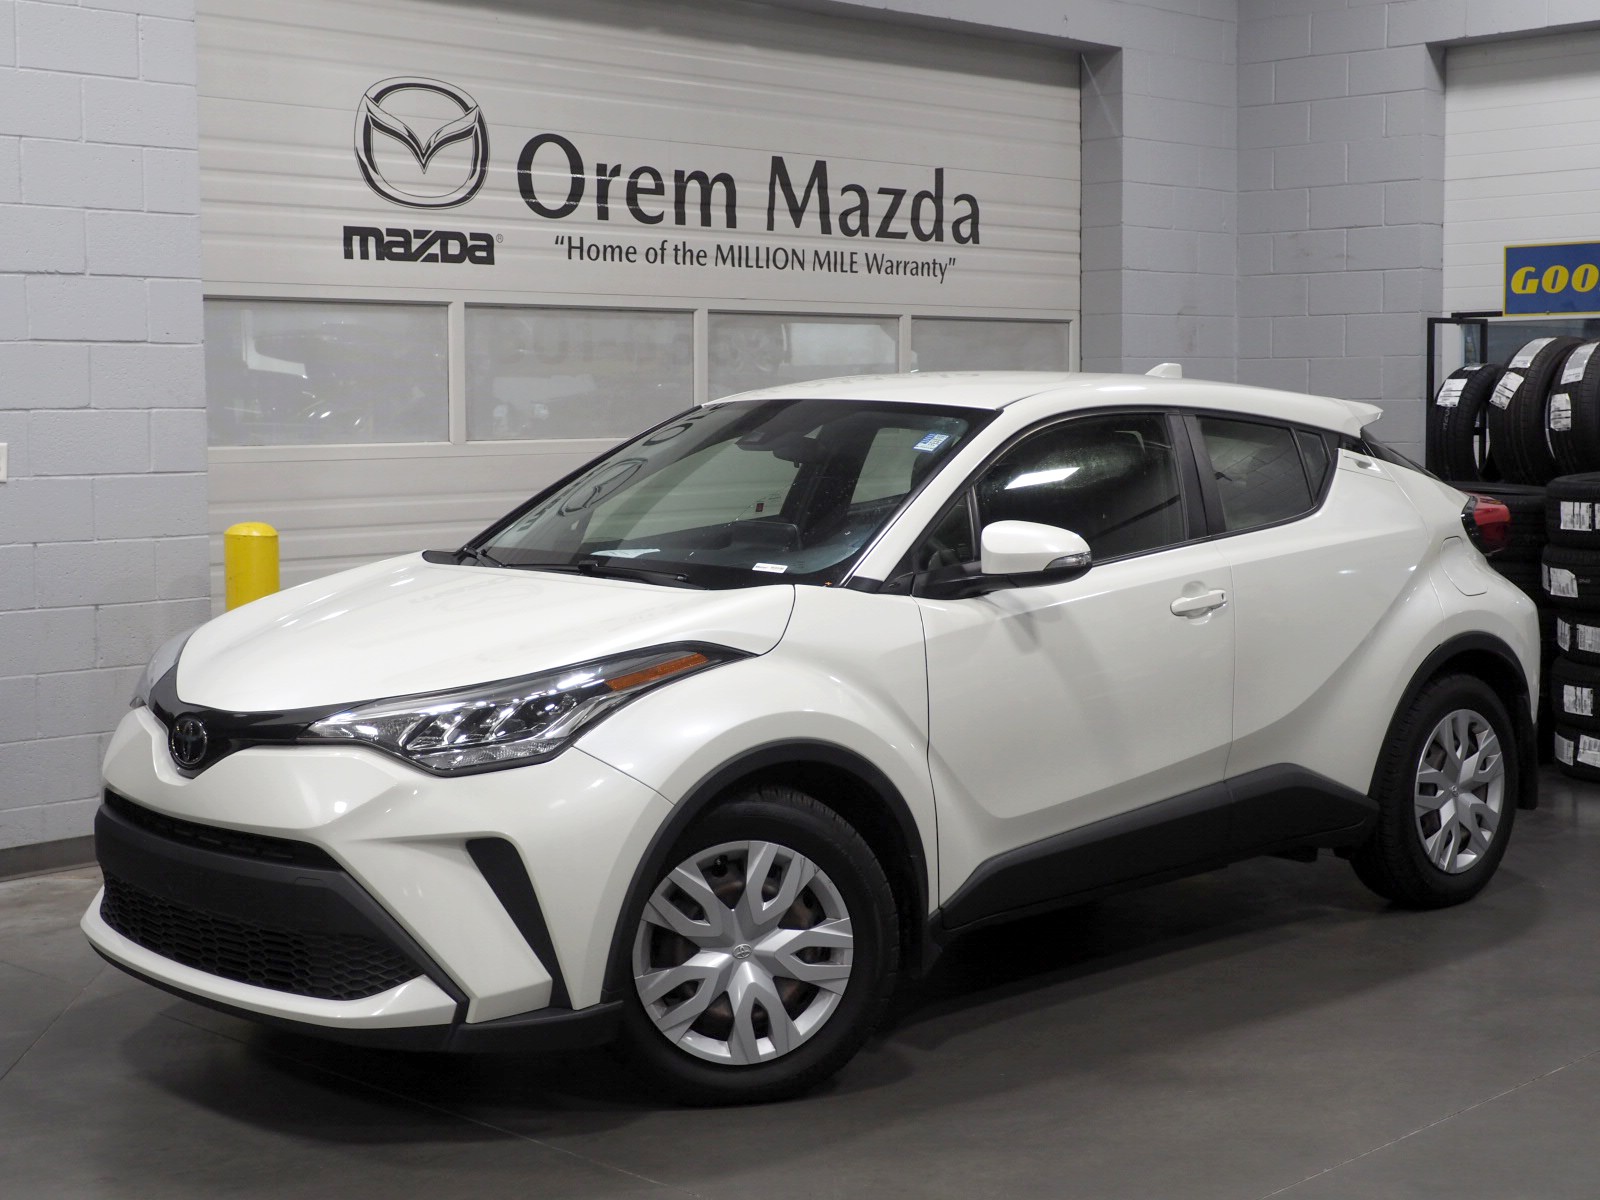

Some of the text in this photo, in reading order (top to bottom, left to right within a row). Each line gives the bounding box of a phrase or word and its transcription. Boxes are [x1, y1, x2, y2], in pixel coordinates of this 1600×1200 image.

[517, 132, 980, 245] Orem Mazda
[645, 239, 670, 265] of
[672, 240, 708, 267] the
[714, 243, 805, 272] MILLION
[812, 249, 859, 274] MILE
